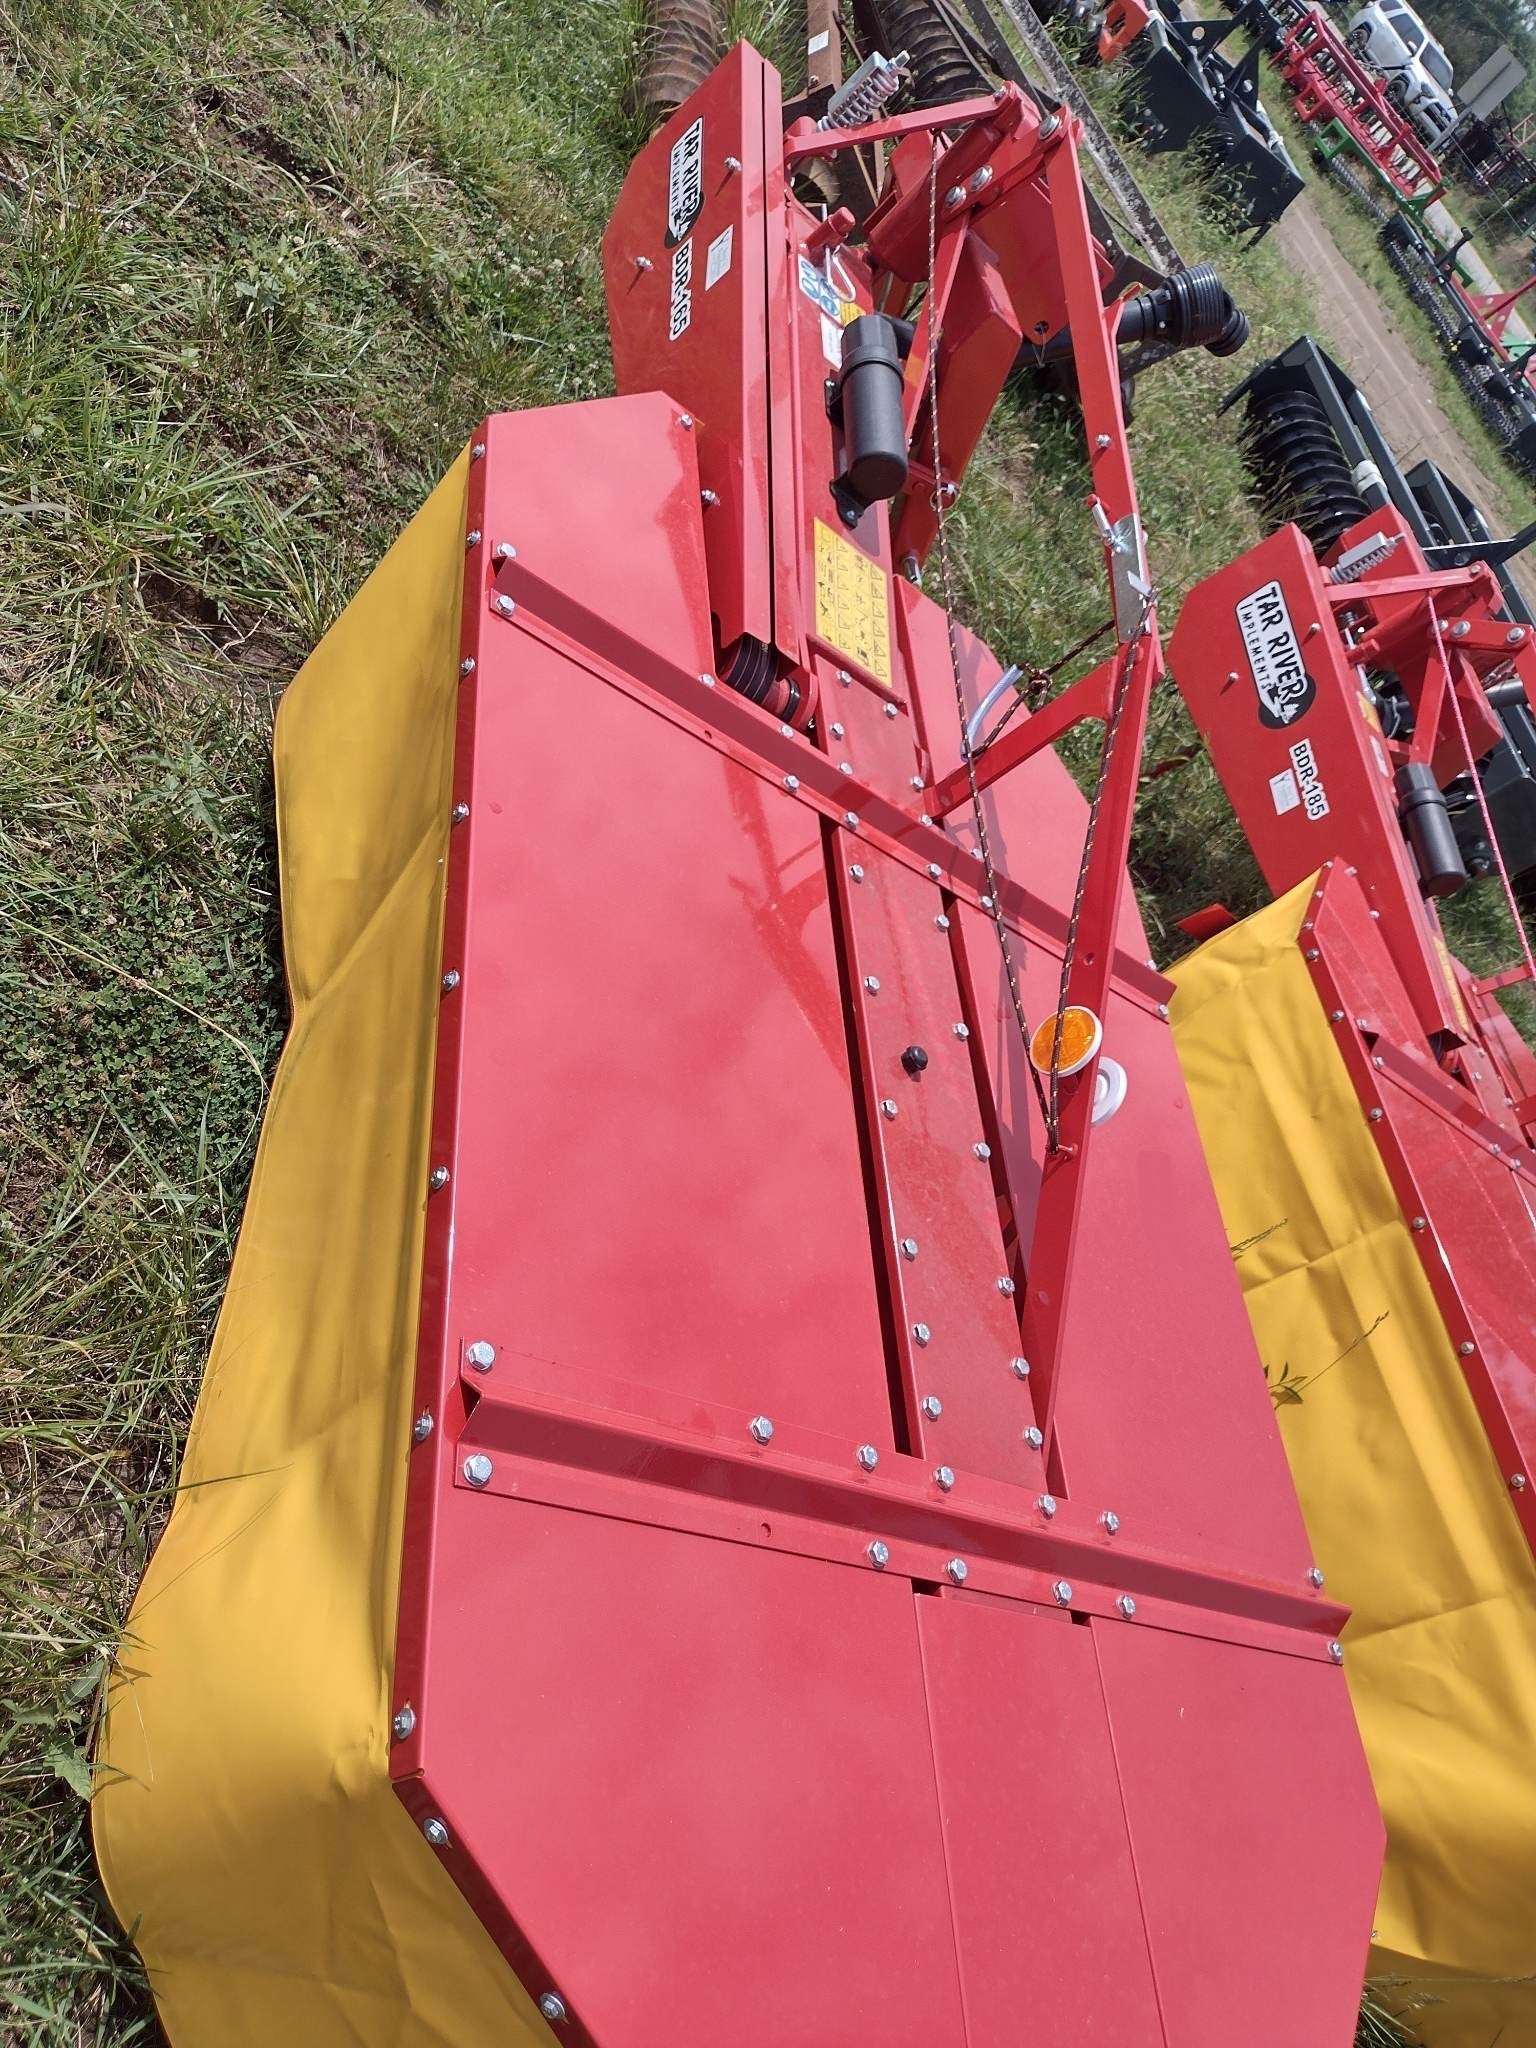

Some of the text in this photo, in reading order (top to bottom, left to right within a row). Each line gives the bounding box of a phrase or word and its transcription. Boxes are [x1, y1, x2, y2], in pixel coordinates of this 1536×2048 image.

[671, 144, 682, 216] IMPLEMENTS
[681, 123, 700, 217] TAR RIVER
[672, 244, 690, 335] BDR-165
[1240, 603, 1273, 690] IMPLEMENTS
[1255, 586, 1305, 701] TAR RIVER
[1293, 742, 1326, 817] BDR-185
